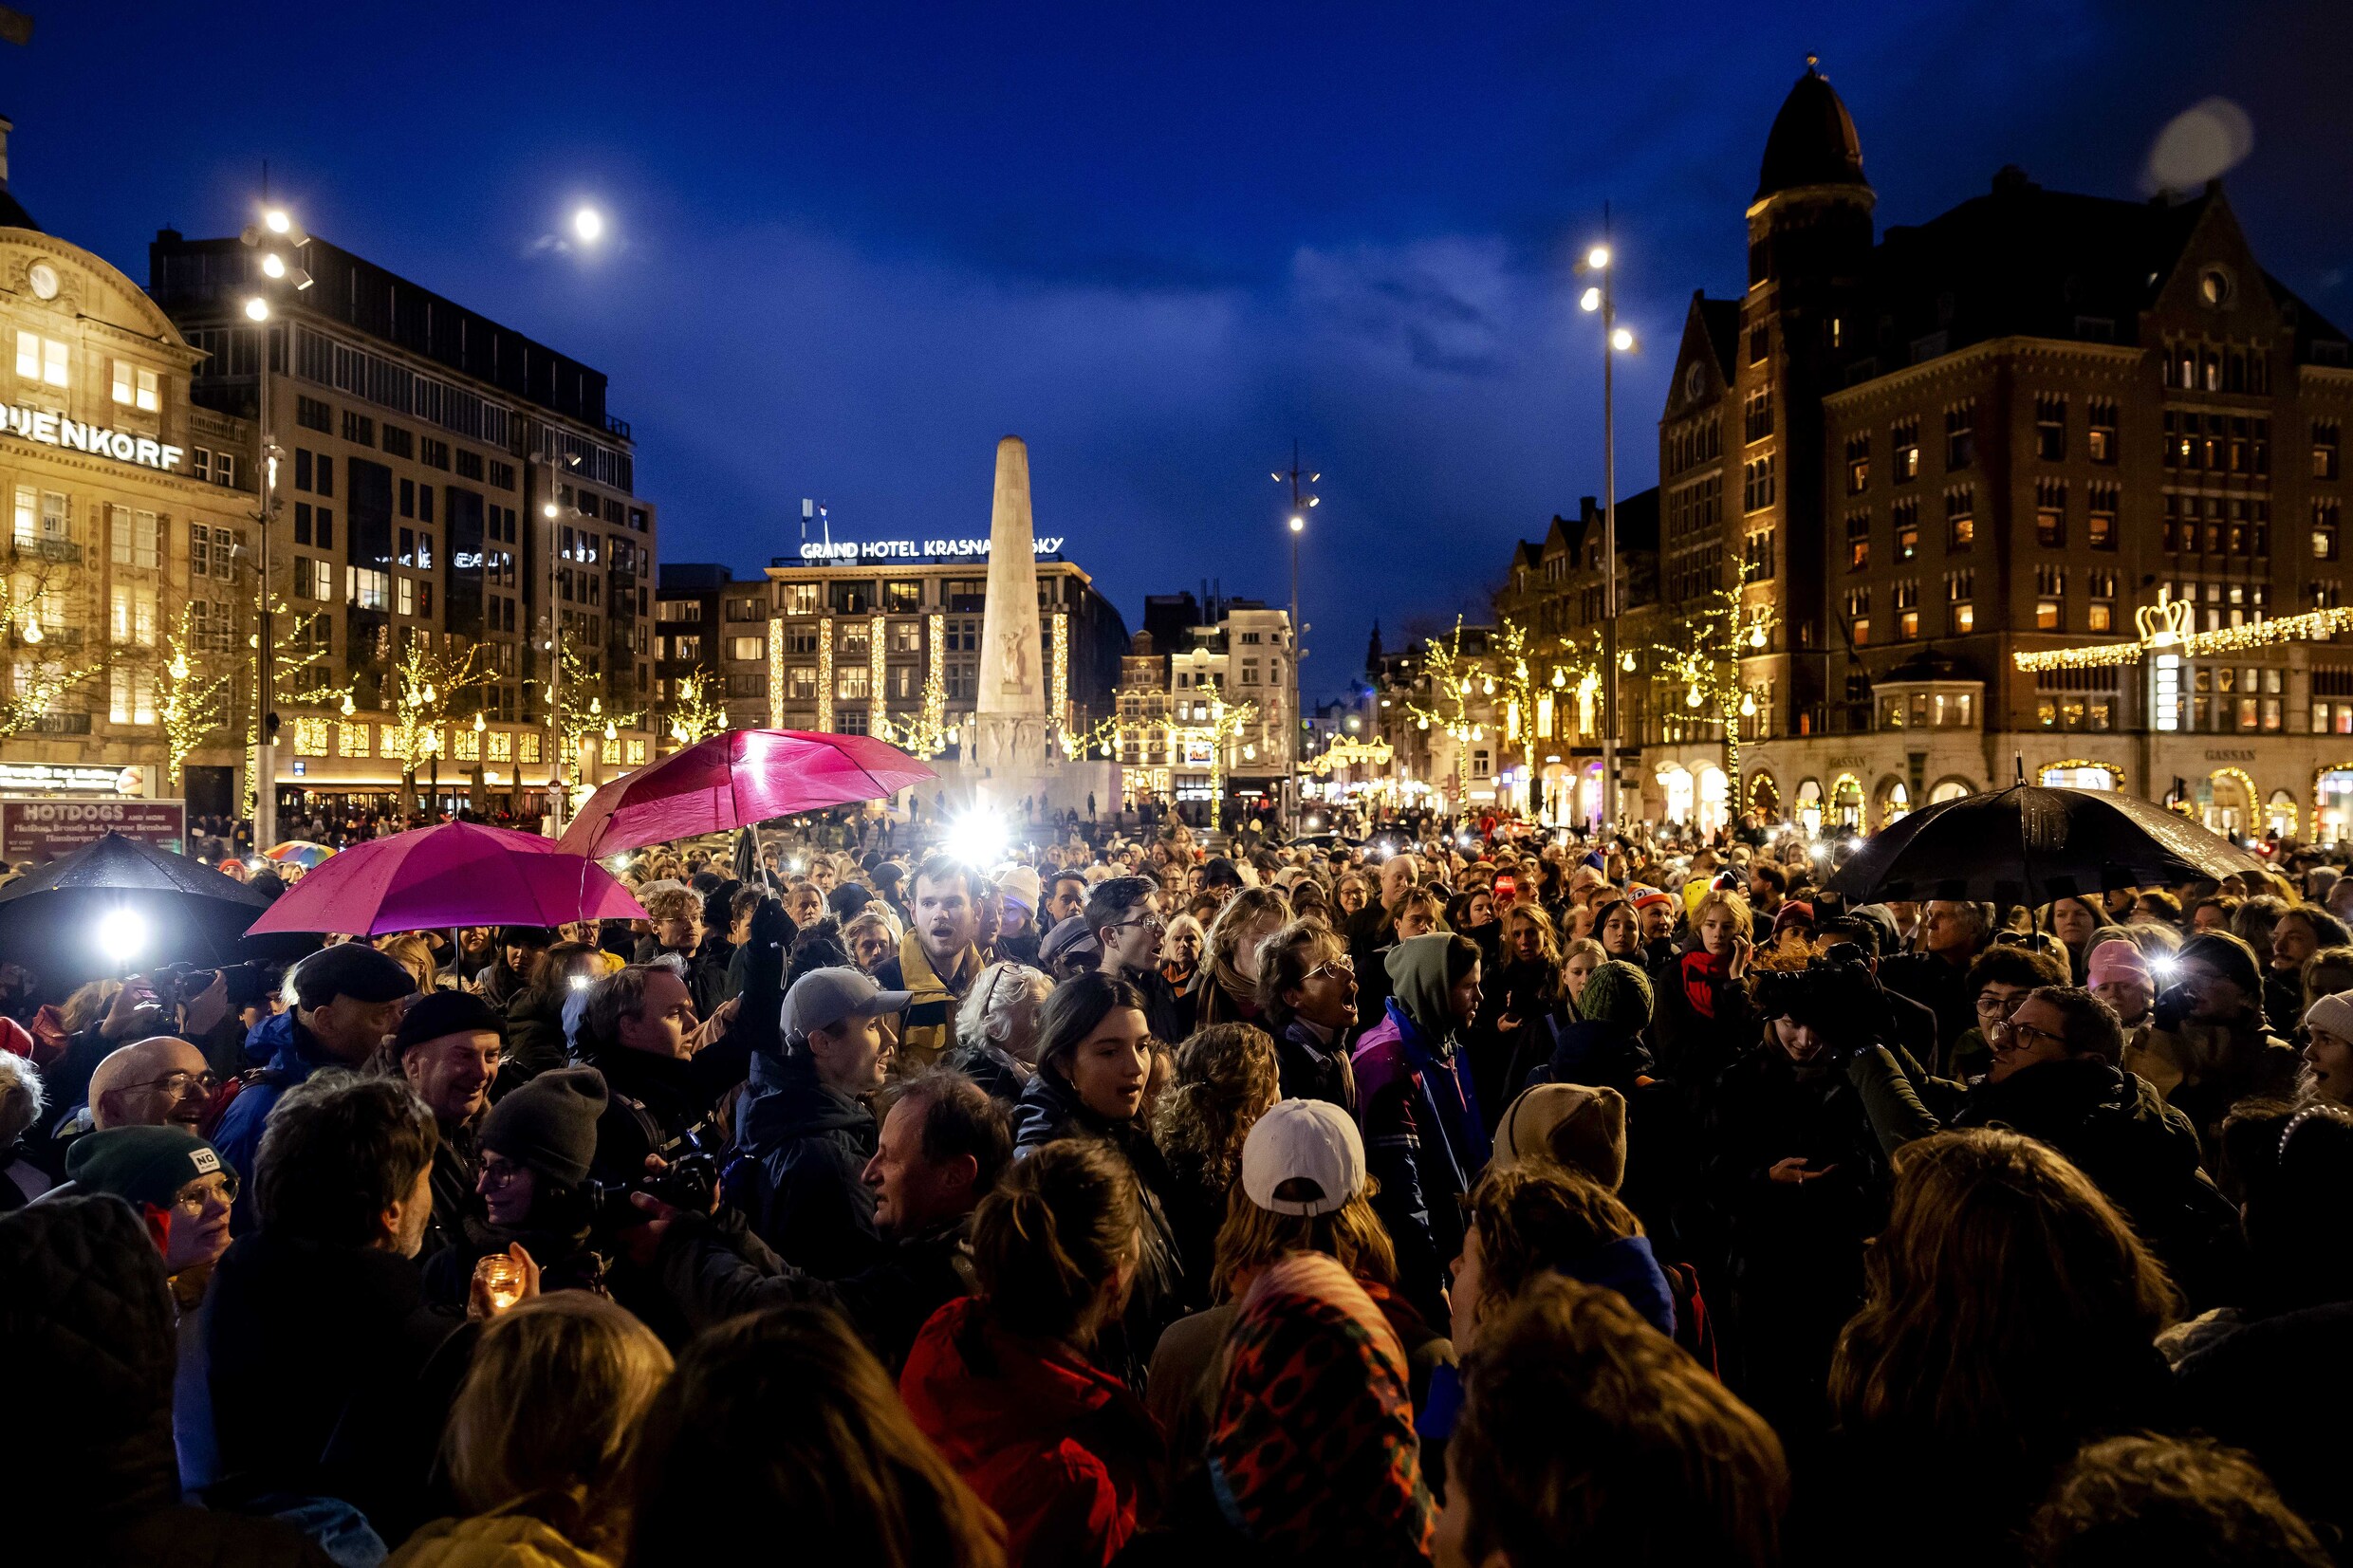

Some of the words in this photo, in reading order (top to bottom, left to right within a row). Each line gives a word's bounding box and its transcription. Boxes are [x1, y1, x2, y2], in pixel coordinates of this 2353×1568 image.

[800, 542, 859, 559] GRAND
[862, 540, 920, 558] HOTEL
[924, 537, 1065, 557] KRASNAKY
[2205, 748, 2256, 761] GASSAN
[23, 804, 124, 821] HOTDOGS
[53, 823, 87, 833] Broodje
[196, 1153, 214, 1166] NO
